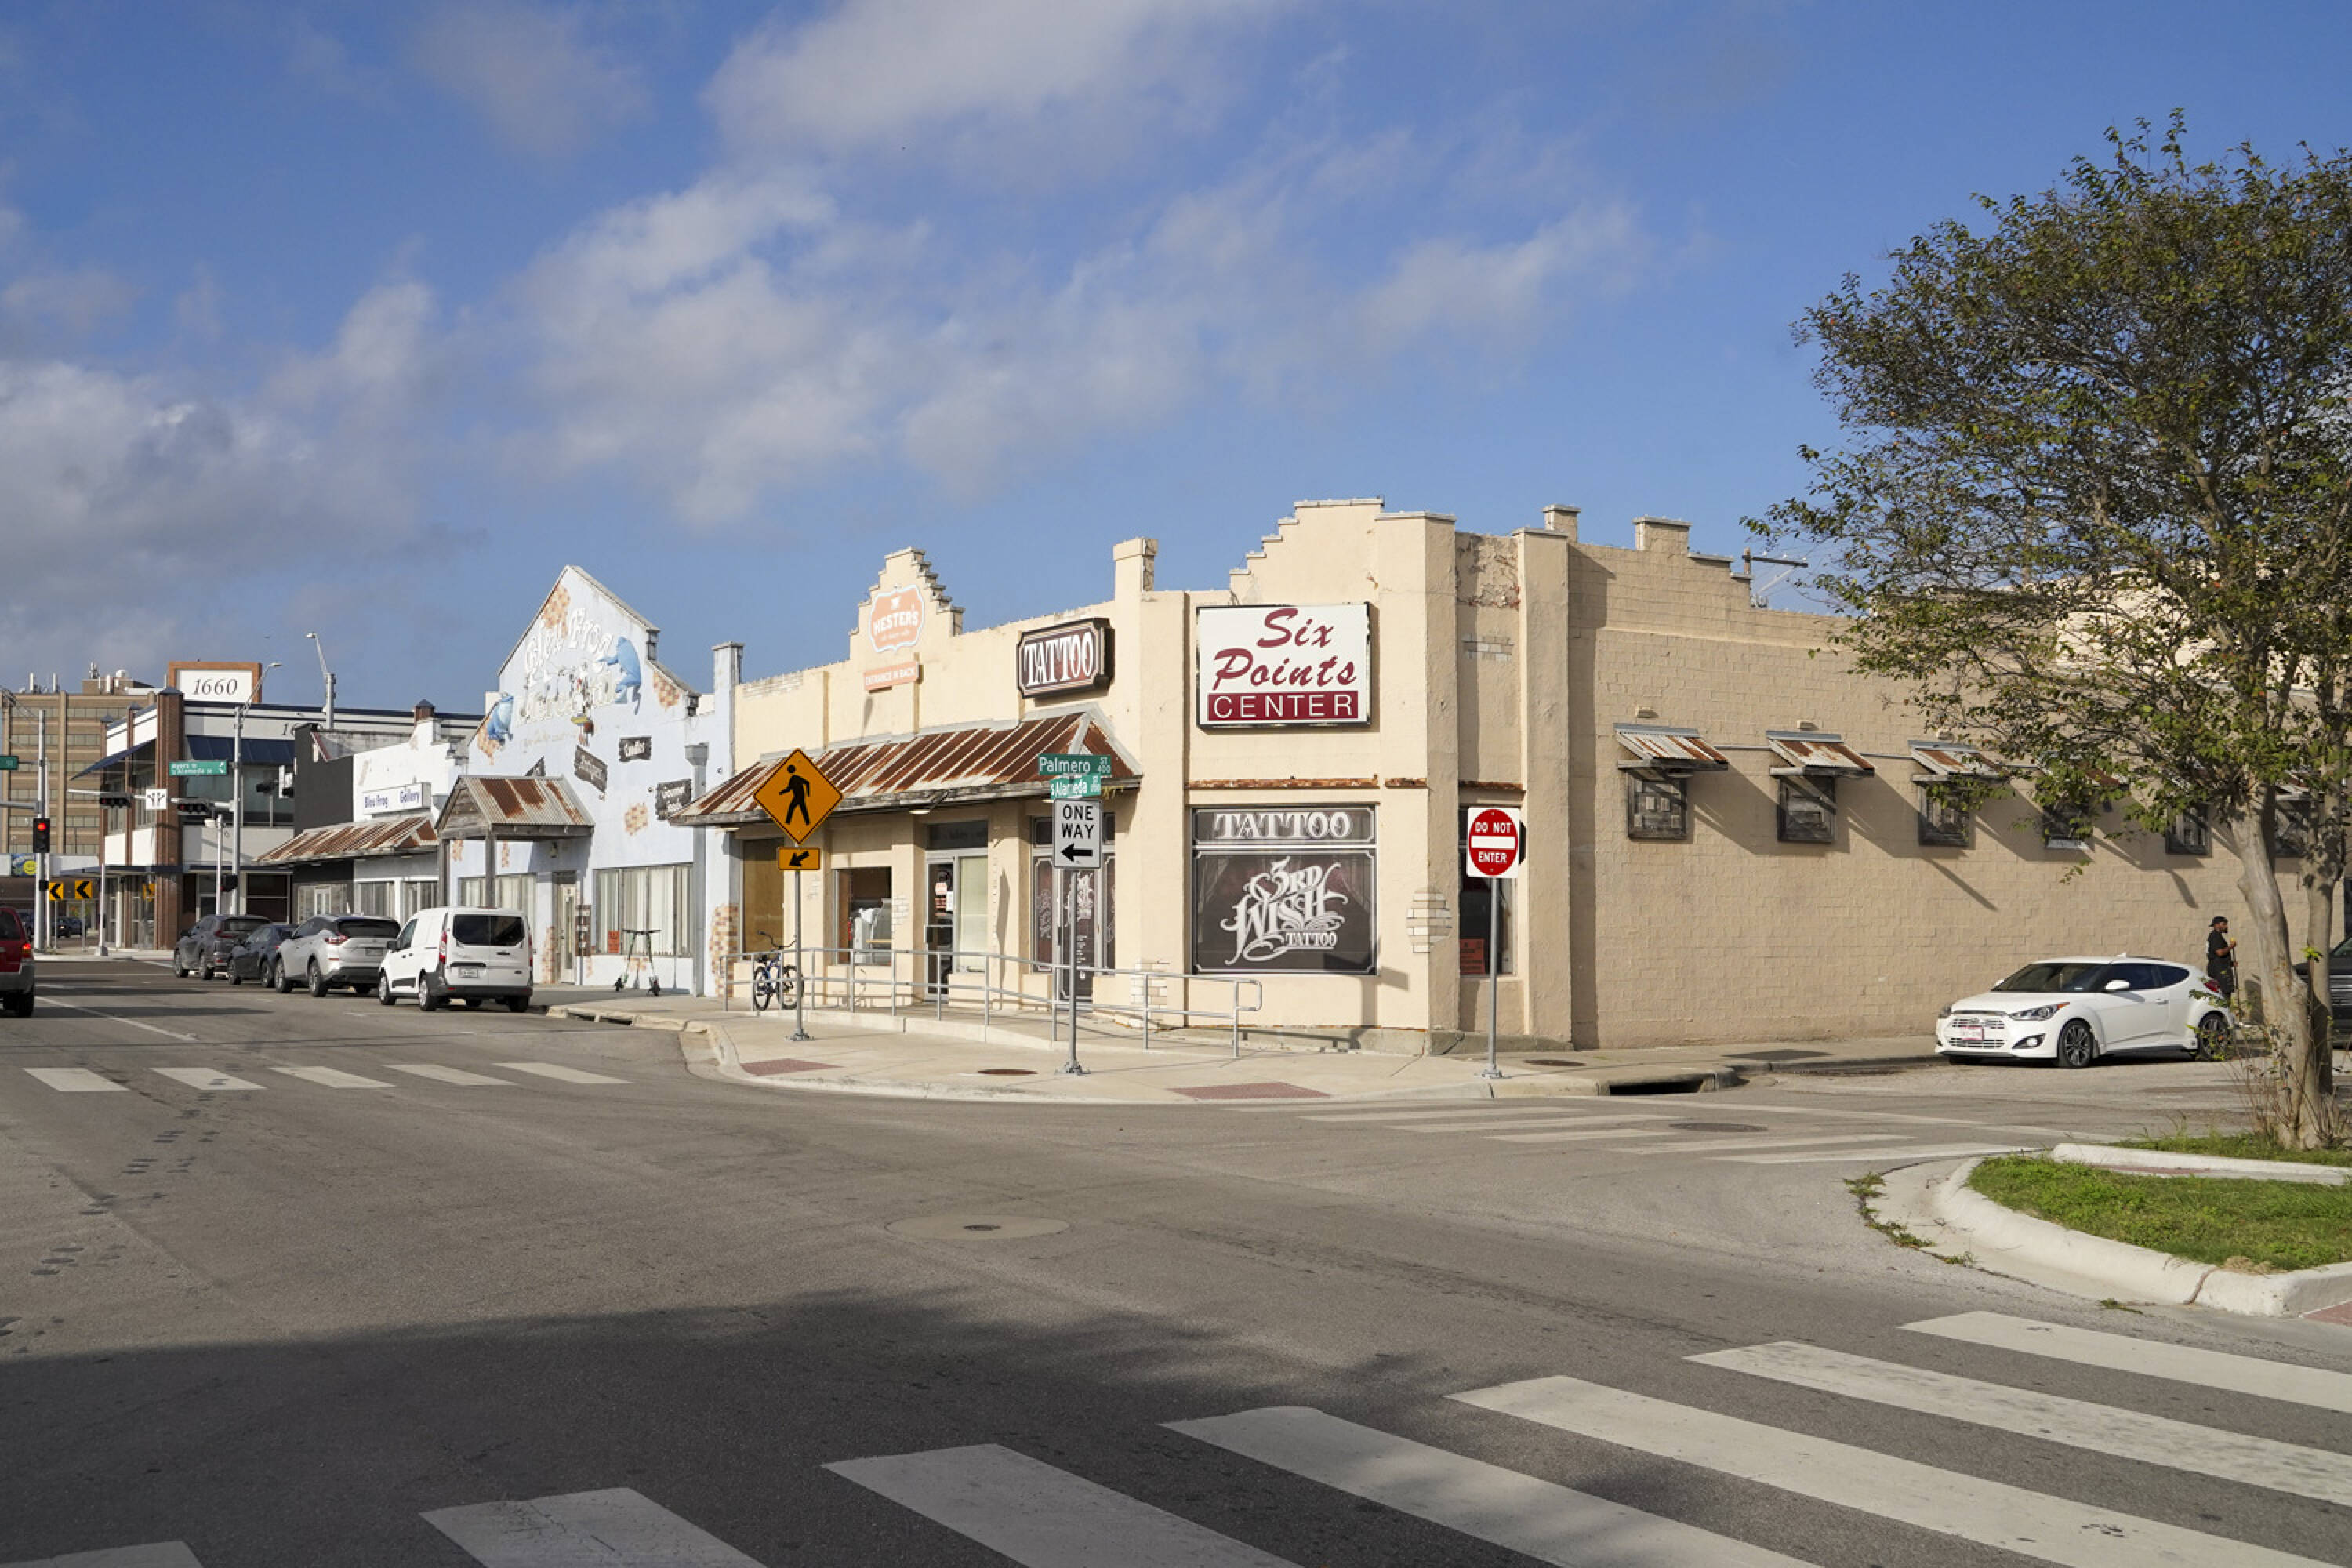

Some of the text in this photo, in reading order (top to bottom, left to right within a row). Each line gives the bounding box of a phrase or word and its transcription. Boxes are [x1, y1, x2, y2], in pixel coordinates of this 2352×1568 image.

[873, 603, 919, 636] HESTER'S
[1256, 608, 1334, 648] Six
[1024, 631, 1093, 686] TATTOO
[899, 666, 915, 678] BACK
[1212, 647, 1357, 691] Points
[193, 678, 238, 695] 1660
[1213, 693, 1352, 718] CENTER
[1039, 757, 1108, 772] Palmero ST
[1063, 804, 1094, 820] ONE
[1061, 822, 1095, 839] WAY
[1215, 811, 1352, 839] TATTOO
[1475, 821, 1512, 833] DO NOT
[1478, 851, 1508, 864] ENTER
[1285, 931, 1338, 947] TATTOO
